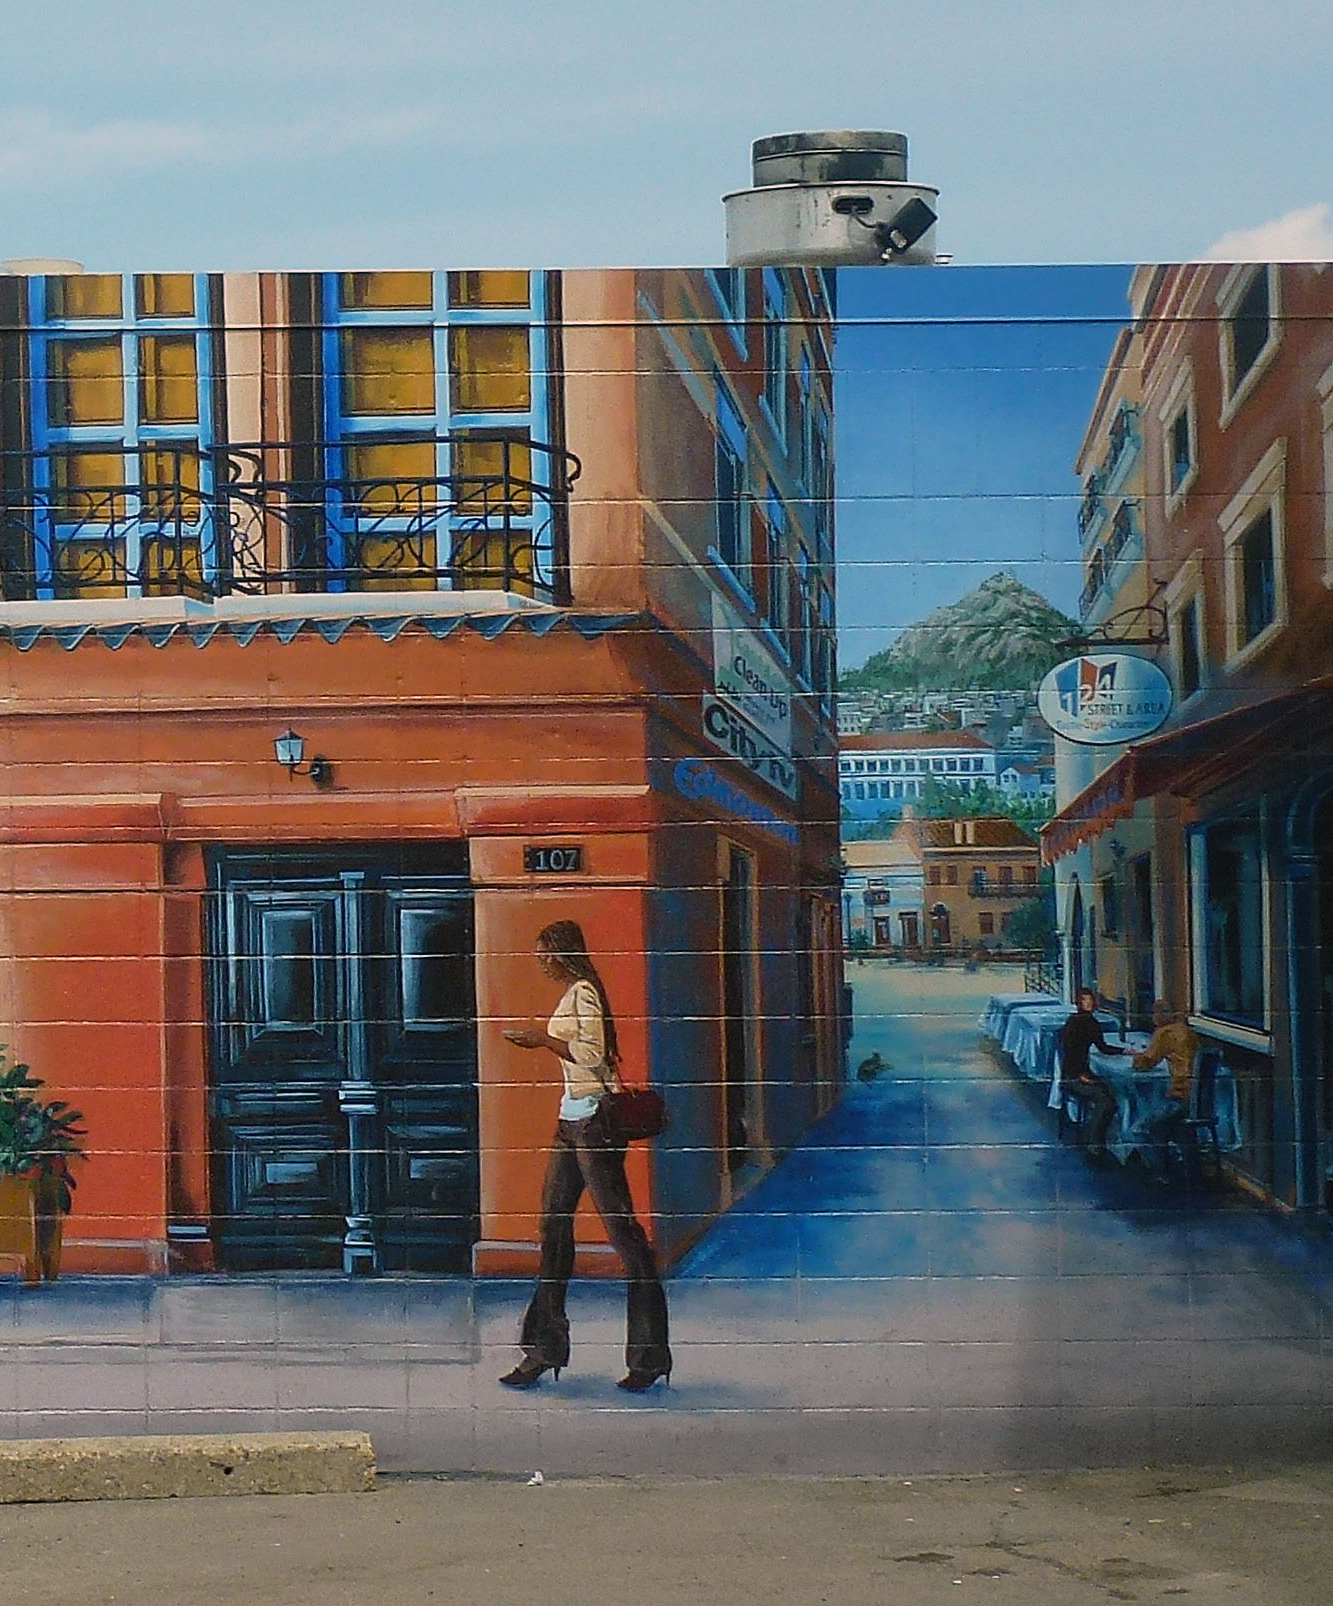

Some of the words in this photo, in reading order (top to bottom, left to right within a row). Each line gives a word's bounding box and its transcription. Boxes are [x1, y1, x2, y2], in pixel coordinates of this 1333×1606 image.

[1087, 703, 1122, 715] STREET
[1137, 702, 1165, 715] AREA
[536, 849, 578, 870] 107
